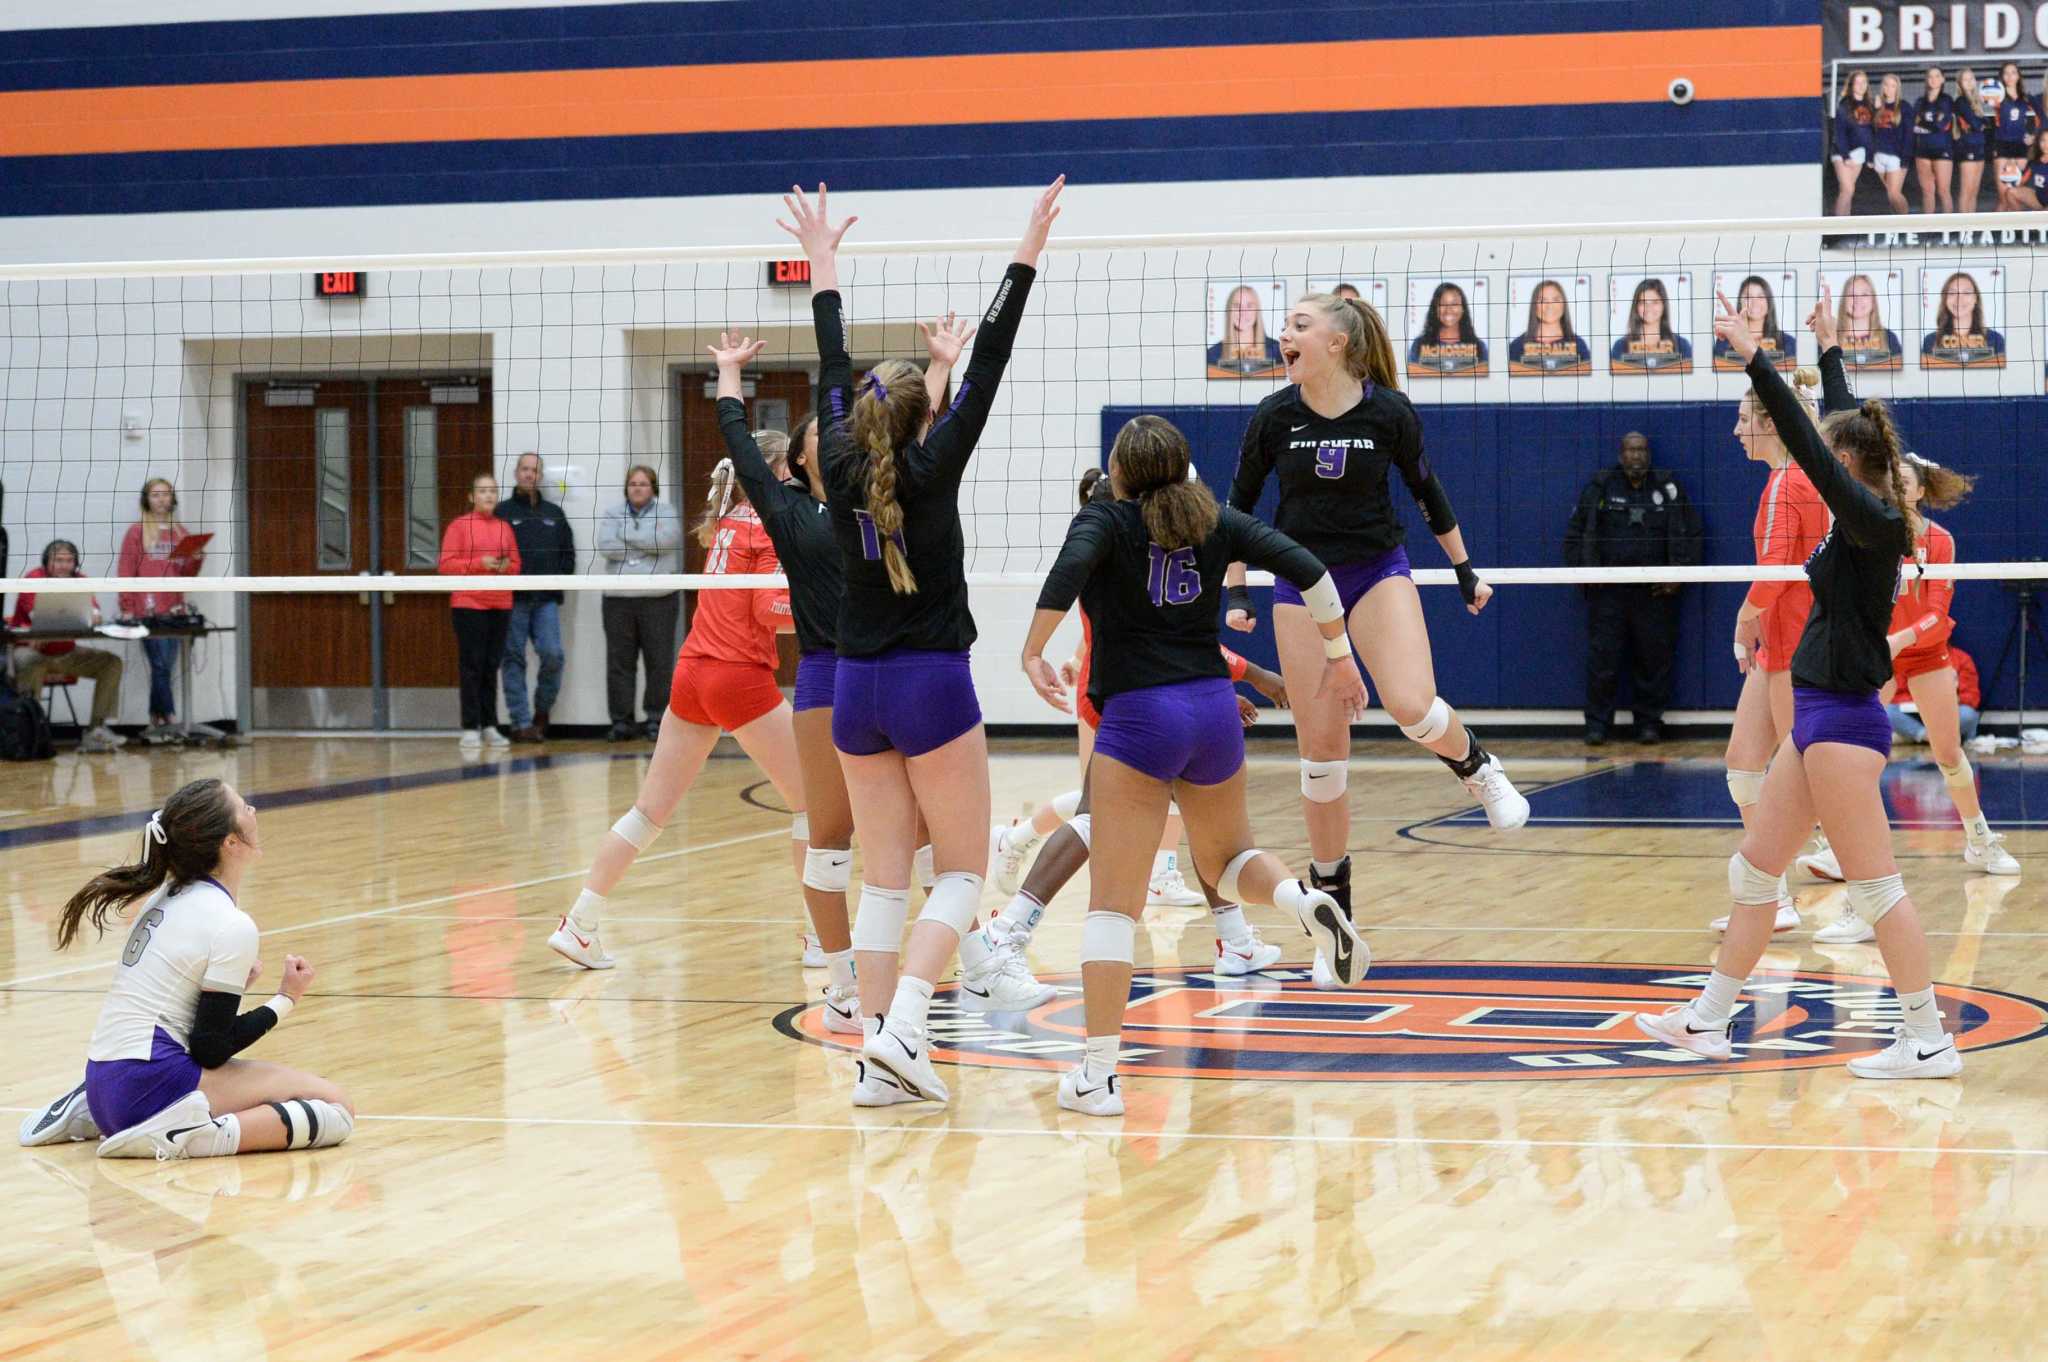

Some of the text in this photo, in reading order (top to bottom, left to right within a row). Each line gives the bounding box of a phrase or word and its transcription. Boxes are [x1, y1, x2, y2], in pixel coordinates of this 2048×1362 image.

[986, 278, 1013, 323] CHARGERS
[1315, 446, 1348, 480] 9
[1146, 541, 1202, 607] 16
[122, 907, 165, 968] 6
